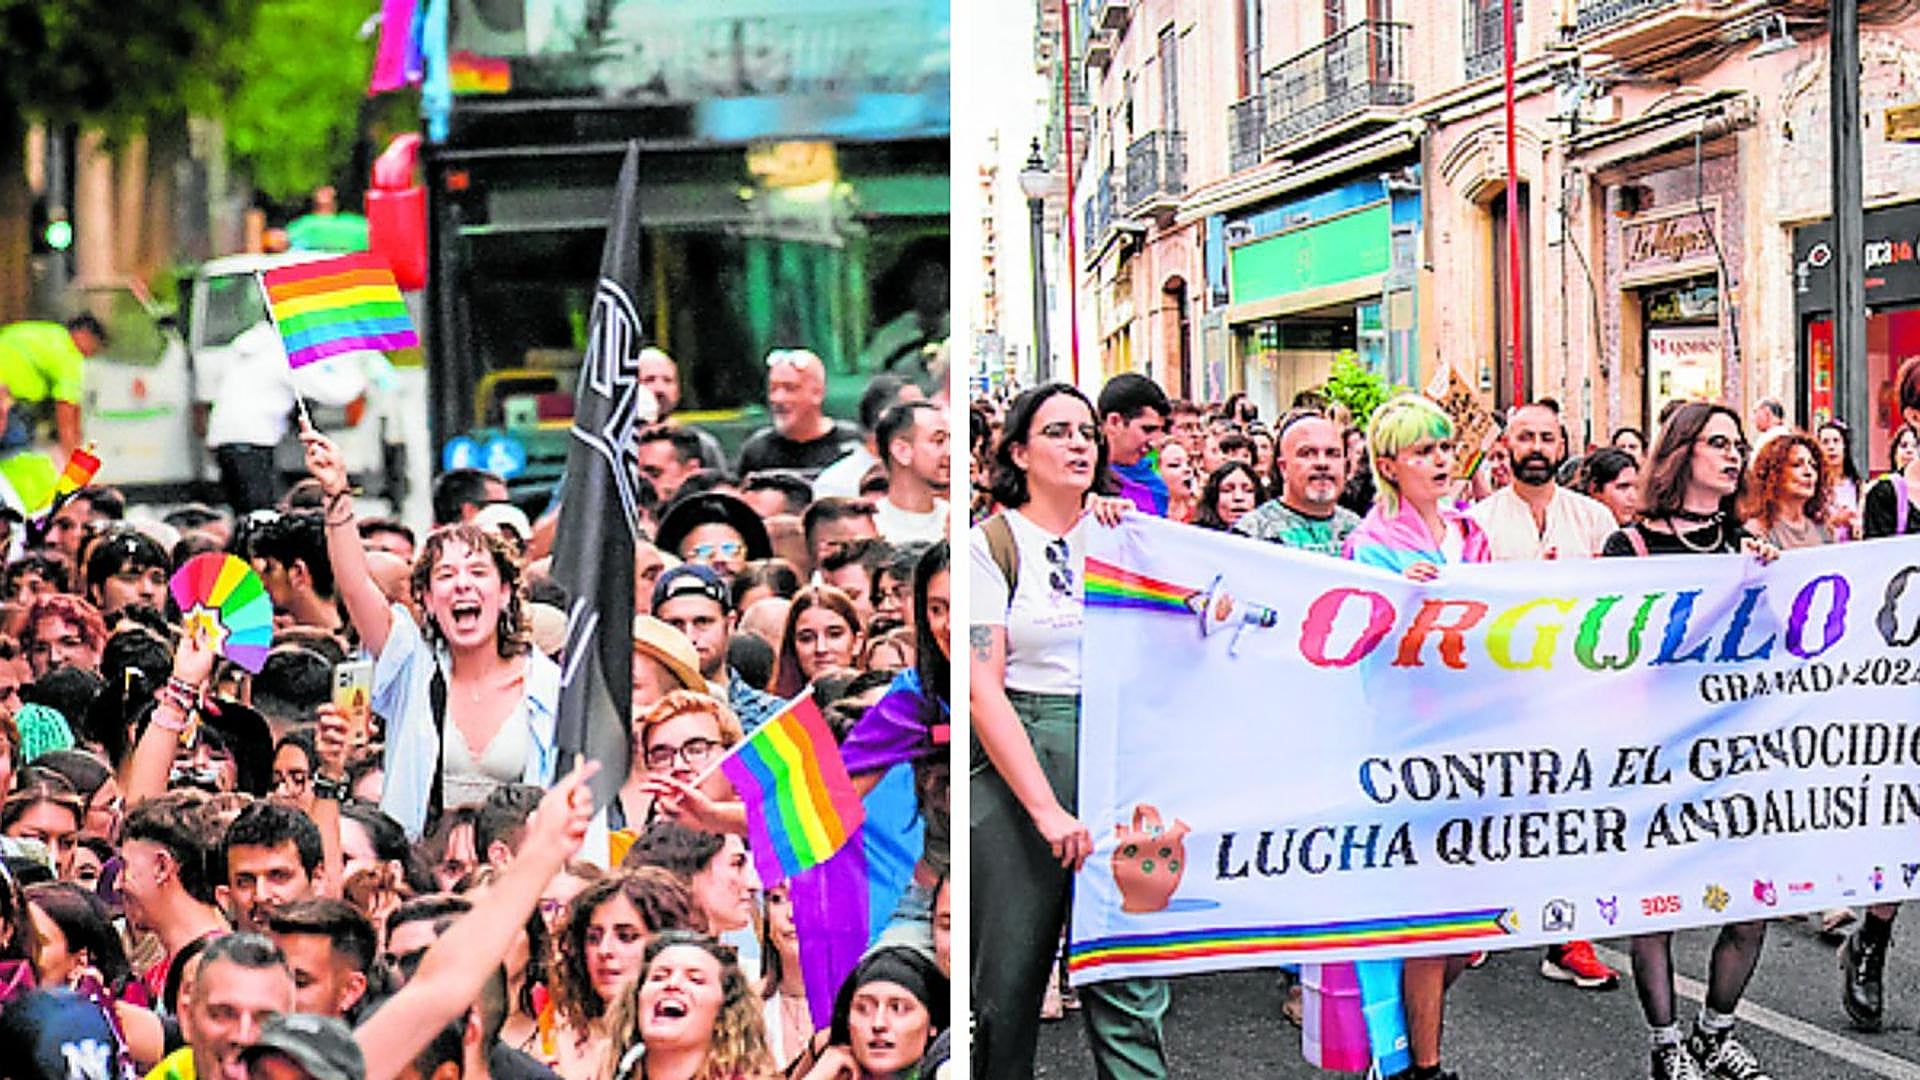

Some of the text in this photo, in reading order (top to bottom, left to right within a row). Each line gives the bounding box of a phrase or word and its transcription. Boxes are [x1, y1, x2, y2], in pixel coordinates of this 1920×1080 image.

[1299, 574, 1850, 669] ORGULLO
[1700, 662, 1850, 703] GRANADA
[1359, 747, 1592, 804] CONTRA
[1609, 745, 1671, 788] EL
[1216, 820, 1418, 880] LUCHA
[1436, 806, 1628, 866] QUEER
[1645, 773, 1870, 849] ANDALUSÍ
